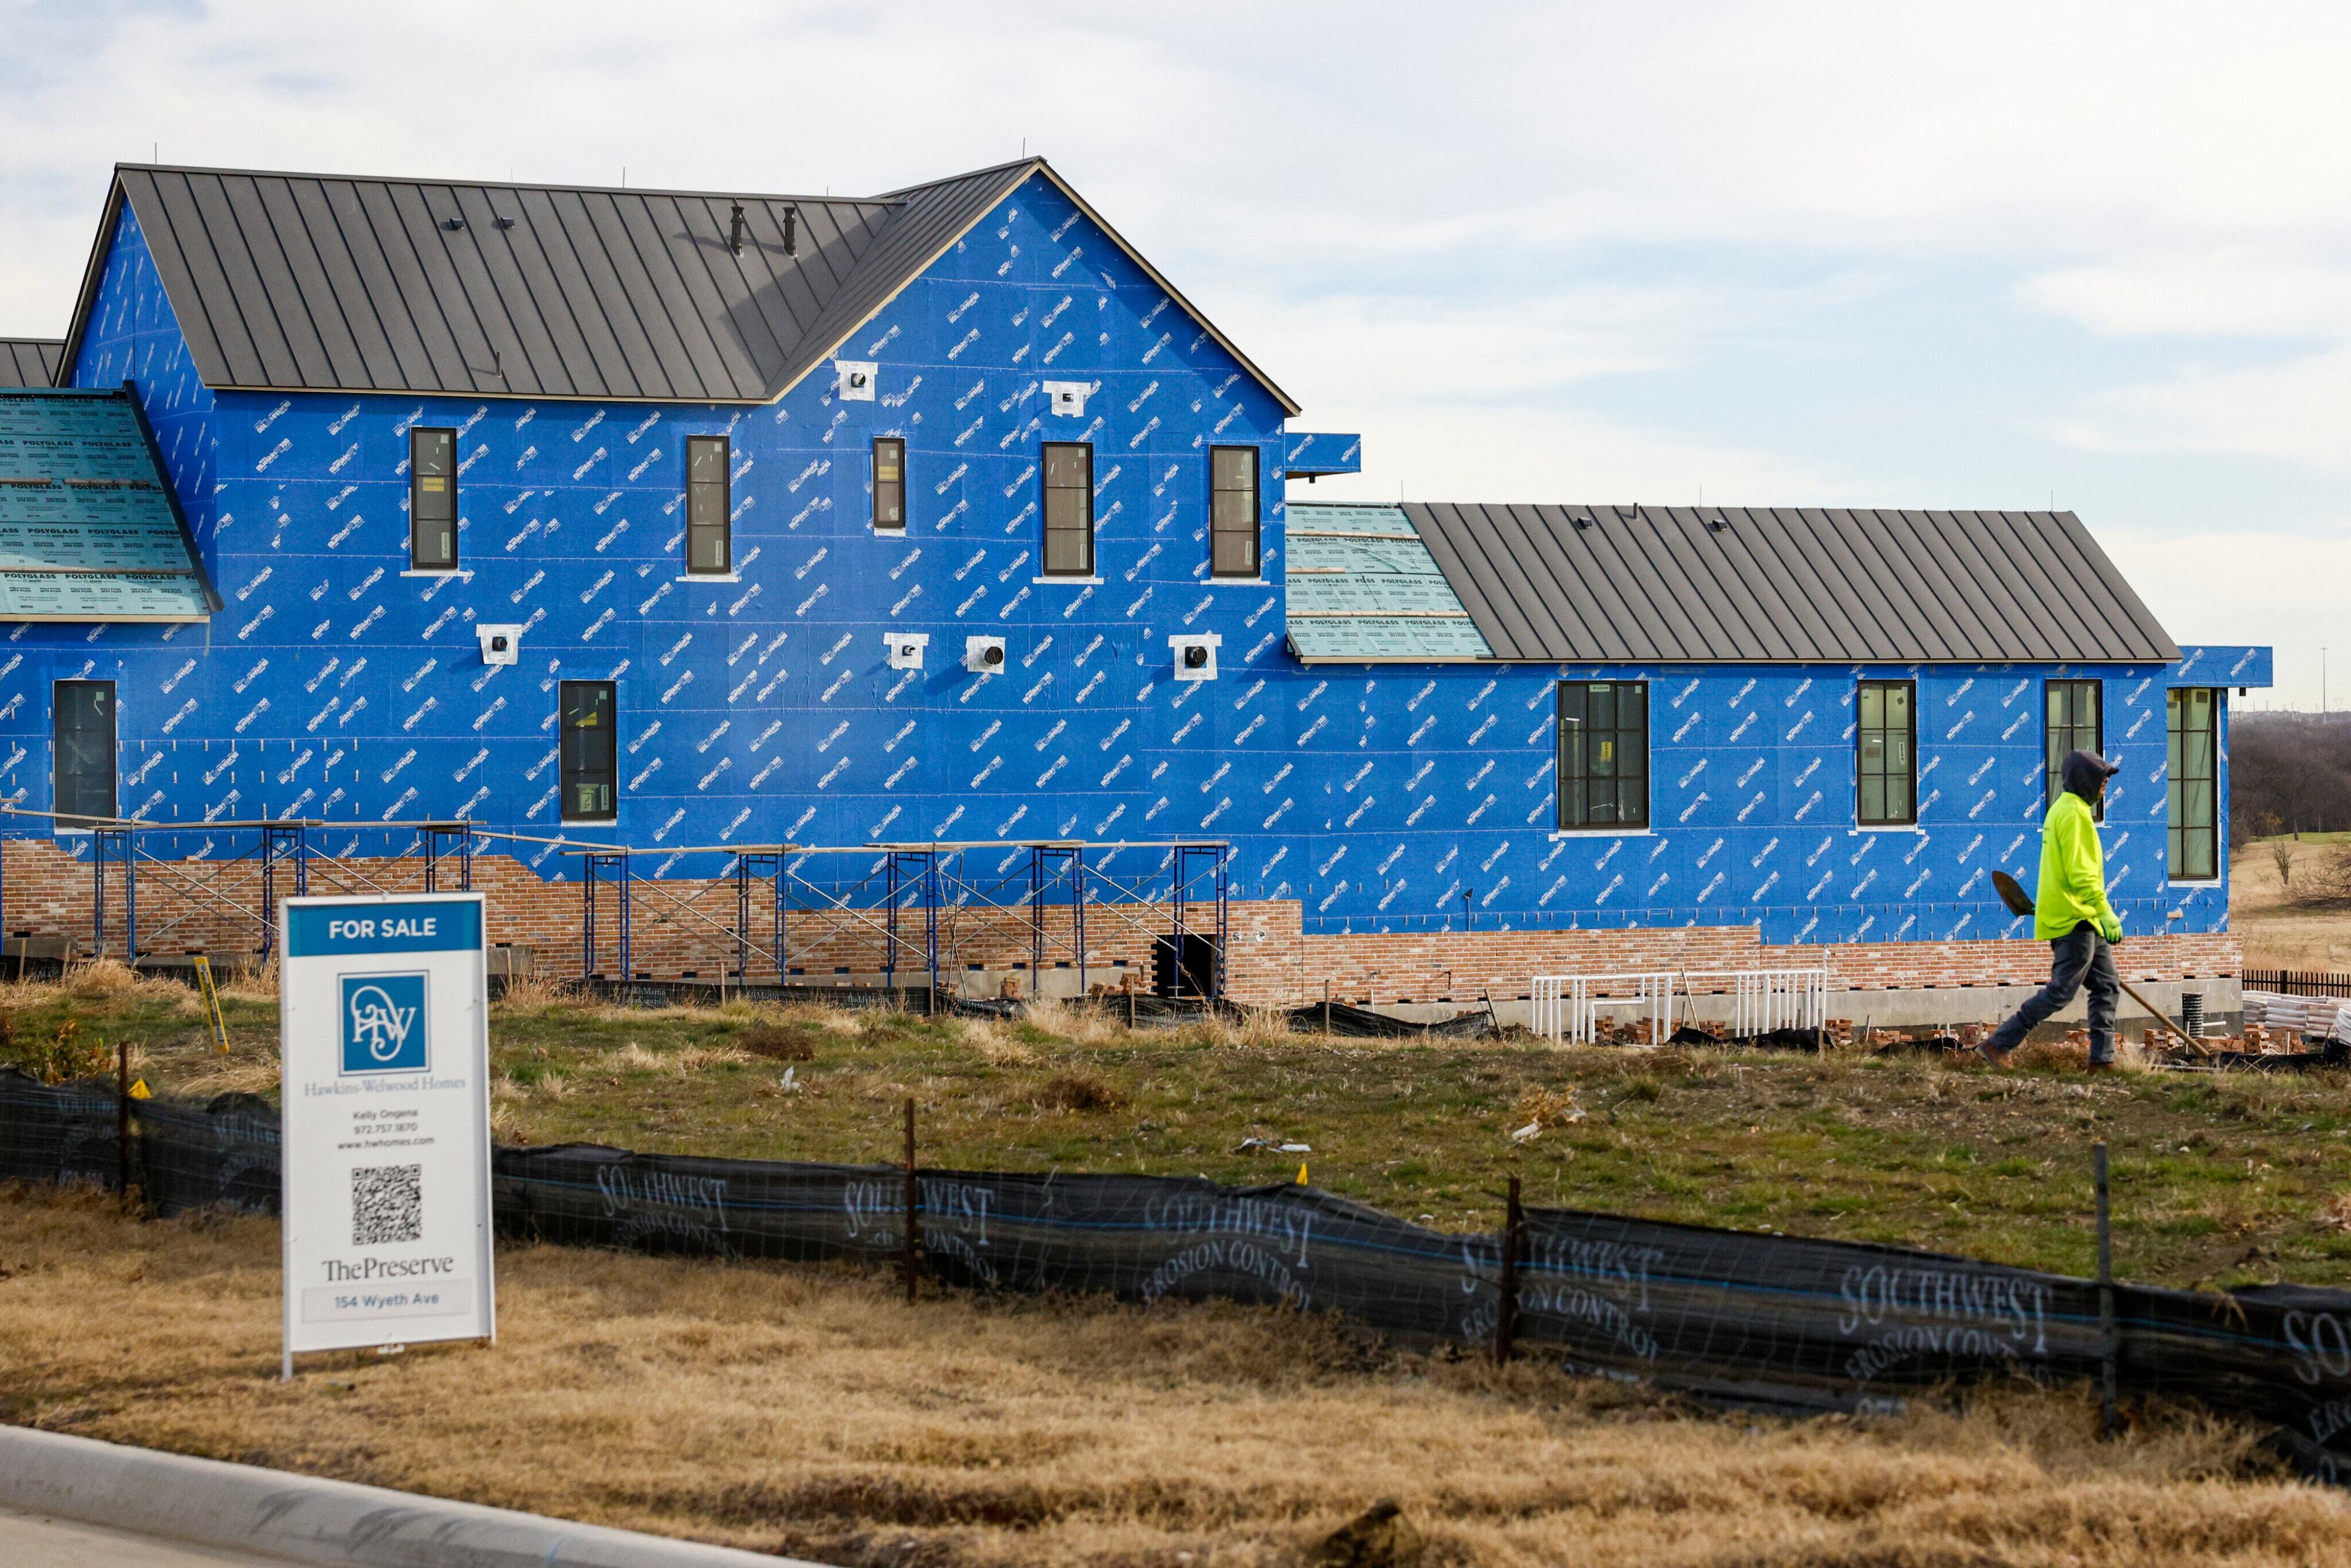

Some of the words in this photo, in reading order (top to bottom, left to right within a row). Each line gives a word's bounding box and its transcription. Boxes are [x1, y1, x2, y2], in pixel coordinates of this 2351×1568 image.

[960, 292, 980, 312] Blueskin
[867, 336, 887, 356] Blueskin
[947, 339, 966, 359] Blueskin
[1043, 343, 1061, 363] Blueskin
[269, 400, 291, 421] Blueskin
[640, 411, 661, 432] Blueskin
[1129, 427, 1148, 448] Blueskin
[255, 450, 277, 471] Blueskin
[572, 458, 593, 480] Blueskin
[808, 547, 828, 568] Blueskin
[902, 548, 922, 568] Blueskin
[251, 567, 273, 588] Blueskin
[594, 570, 615, 591] Blueskin
[795, 595, 815, 615] Blueskin
[955, 596, 974, 616] Blueskin
[1195, 595, 1214, 614] Blueskin
[581, 619, 602, 641] Blueskin
[175, 659, 196, 681] Blueskin
[247, 659, 269, 681] Blueskin
[661, 682, 680, 703] Blueskin
[755, 681, 775, 702] Blueskin
[1022, 683, 1041, 703] Blueskin
[161, 711, 183, 733] Blueskin
[472, 708, 493, 730] Blueskin
[896, 720, 916, 741] Blueskin
[1171, 723, 1190, 743] Blueskin
[1234, 725, 1252, 745] Blueskin
[1467, 725, 1485, 745] Blueskin
[396, 749, 417, 770] Blueskin
[628, 769, 648, 790] Blueskin
[697, 769, 718, 789] Blueskin
[748, 768, 769, 788] Blueskin
[970, 767, 989, 788] Blueskin
[1035, 766, 1054, 787] Blueskin
[1355, 761, 1374, 781] Blueskin
[381, 799, 403, 820] Blueskin
[1262, 809, 1281, 828] Blueskin
[1405, 806, 1424, 825] Blueskin
[329, 920, 376, 939] FOR
[381, 917, 437, 938] SALE
[422, 1077, 466, 1090] Homes
[353, 1110, 377, 1121] Kelly
[597, 1164, 729, 1232] SOUTHWEST
[1144, 1194, 1319, 1268] SOUTHWEST
[335, 1296, 357, 1308] 154
[363, 1295, 408, 1309] Wyeth
[413, 1293, 439, 1304] Ave
[1838, 1265, 2054, 1352] SOUTHWEST
